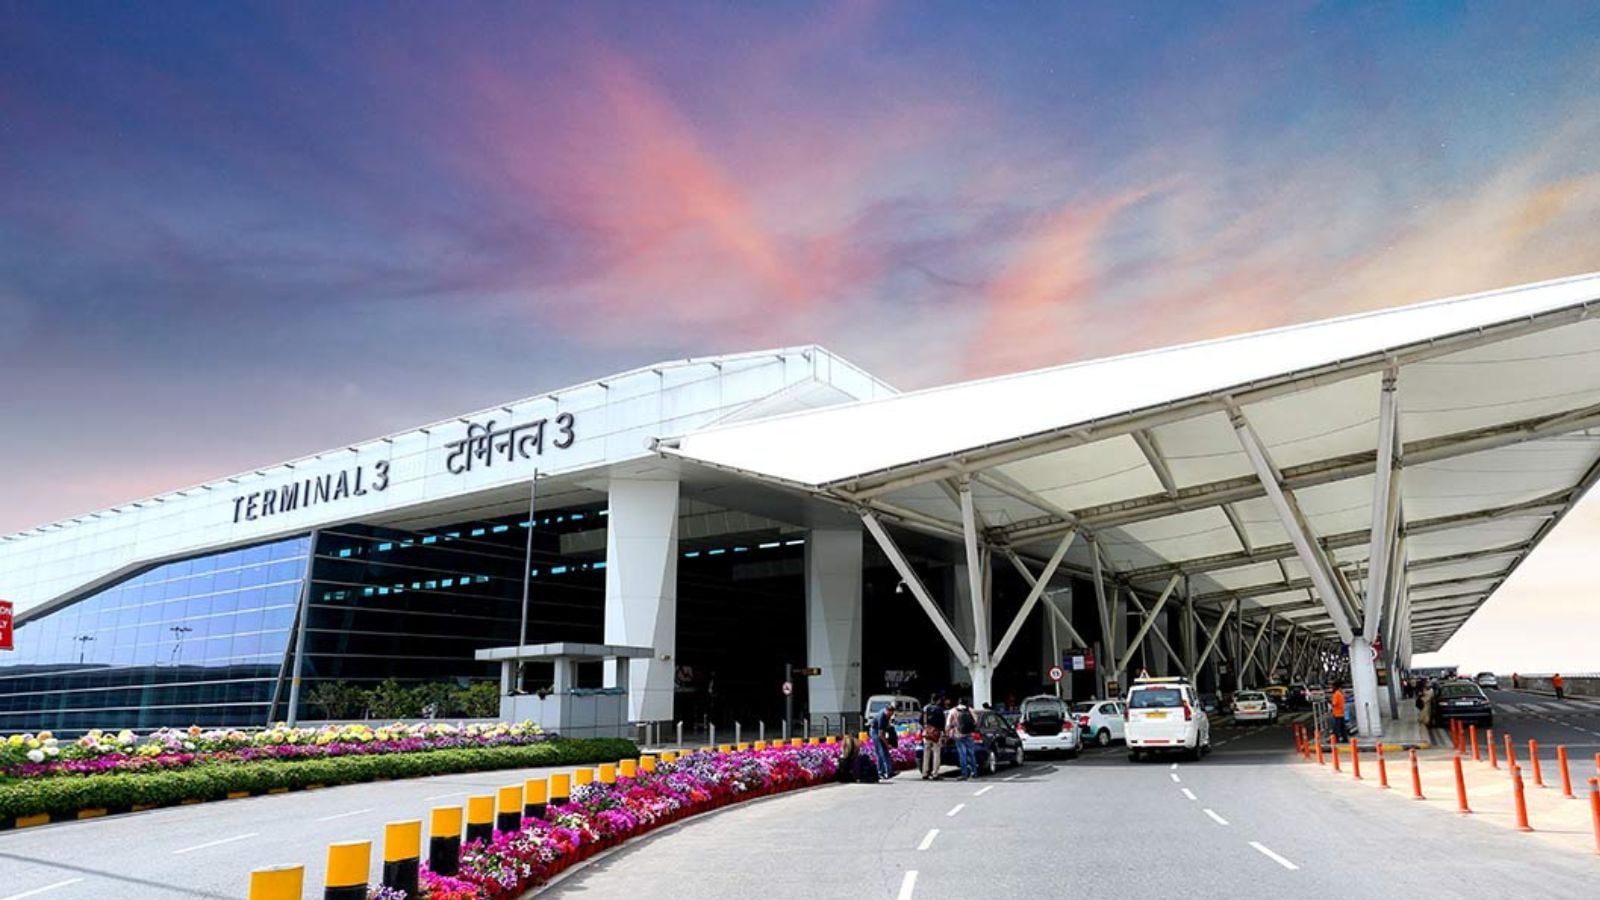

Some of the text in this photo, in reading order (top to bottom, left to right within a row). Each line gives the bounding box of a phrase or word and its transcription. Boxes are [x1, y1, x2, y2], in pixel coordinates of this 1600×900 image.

[444, 412, 575, 475] टर्मिनल 3
[232, 460, 390, 523] TERMINAL 3
